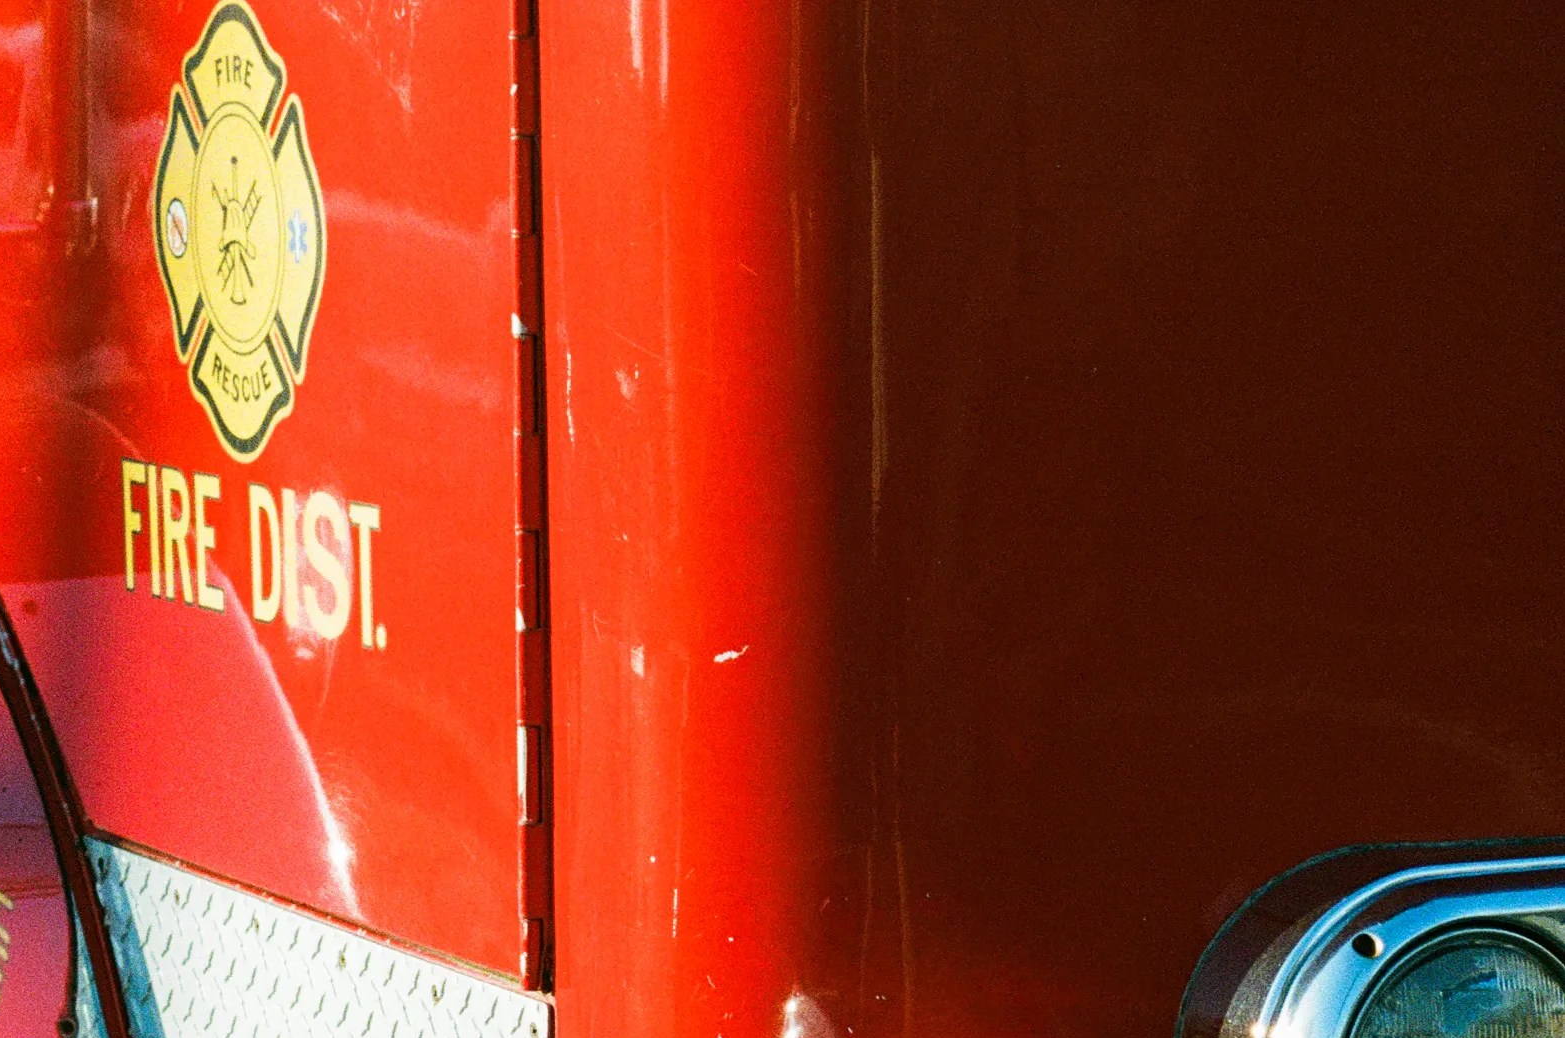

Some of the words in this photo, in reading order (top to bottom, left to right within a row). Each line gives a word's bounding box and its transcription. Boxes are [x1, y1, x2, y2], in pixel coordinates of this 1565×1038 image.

[215, 55, 254, 88] FIRE
[212, 353, 271, 402] RESCUE
[121, 457, 225, 614] FIRE
[249, 482, 387, 649] DIST.
